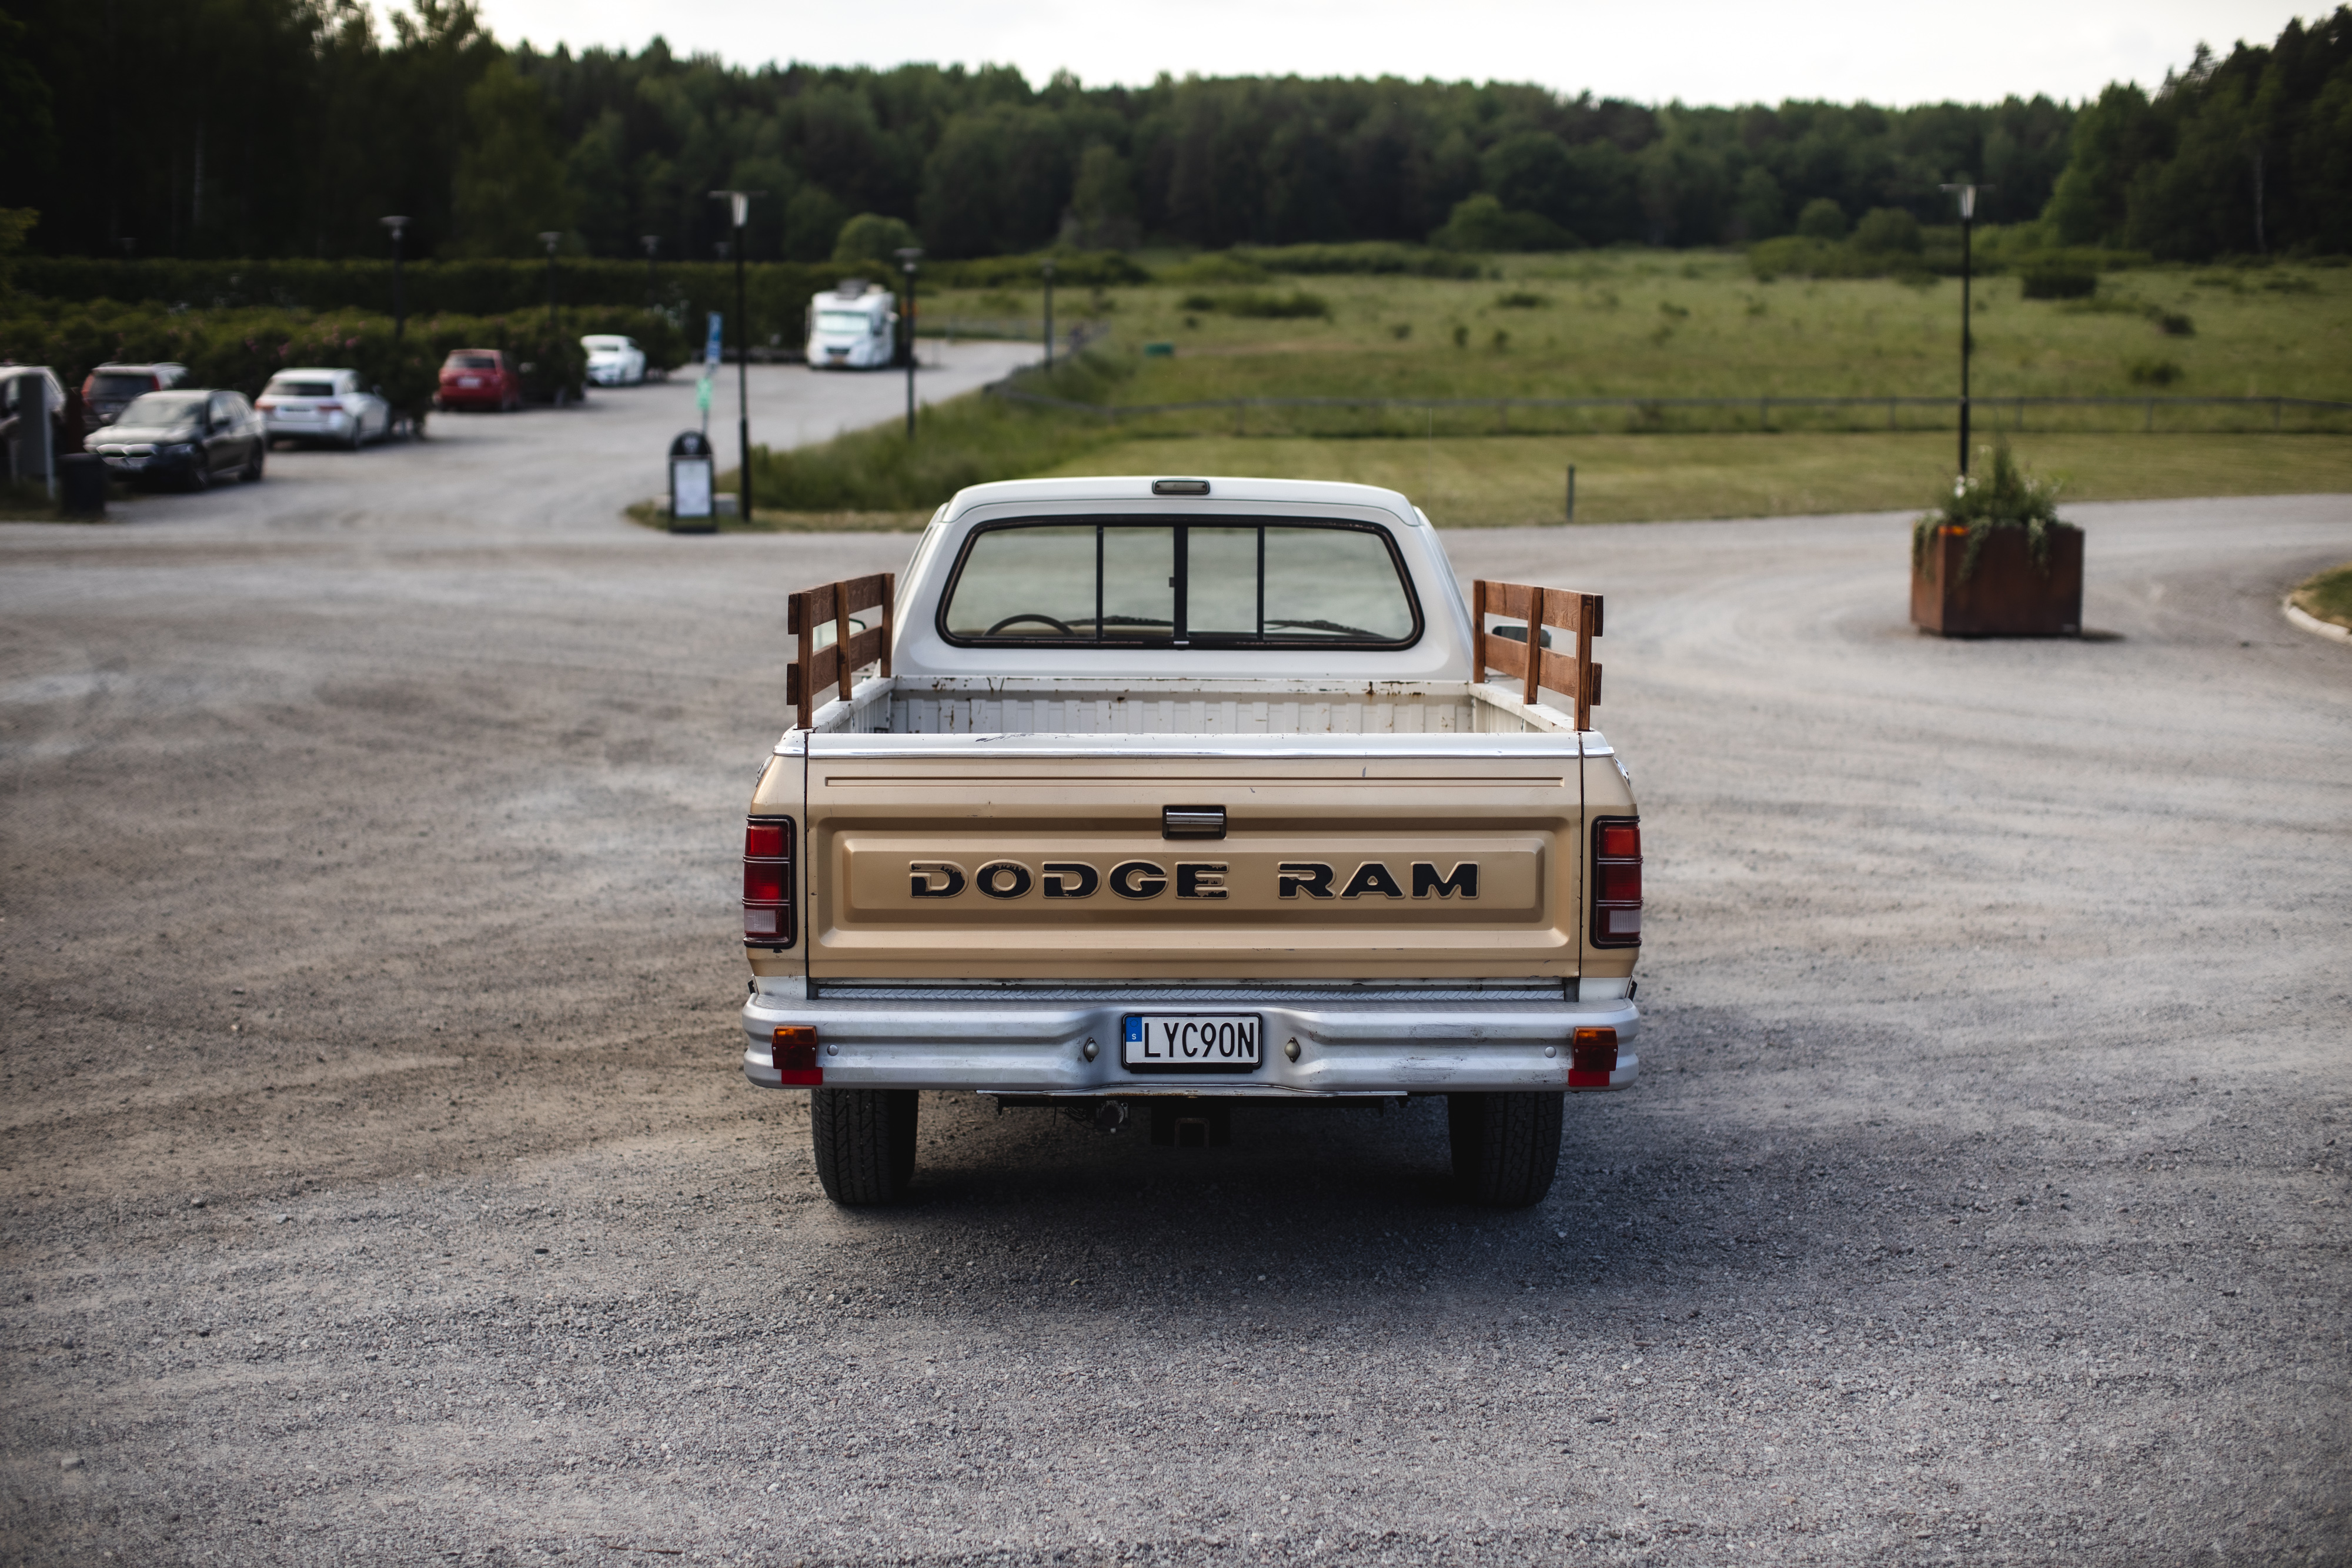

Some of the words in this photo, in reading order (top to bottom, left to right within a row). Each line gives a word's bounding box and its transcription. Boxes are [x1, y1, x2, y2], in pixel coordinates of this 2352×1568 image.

[910, 860, 1230, 900] DODGE
[1278, 861, 1480, 900] RAM
[1144, 1022, 1254, 1058] LYC90N
